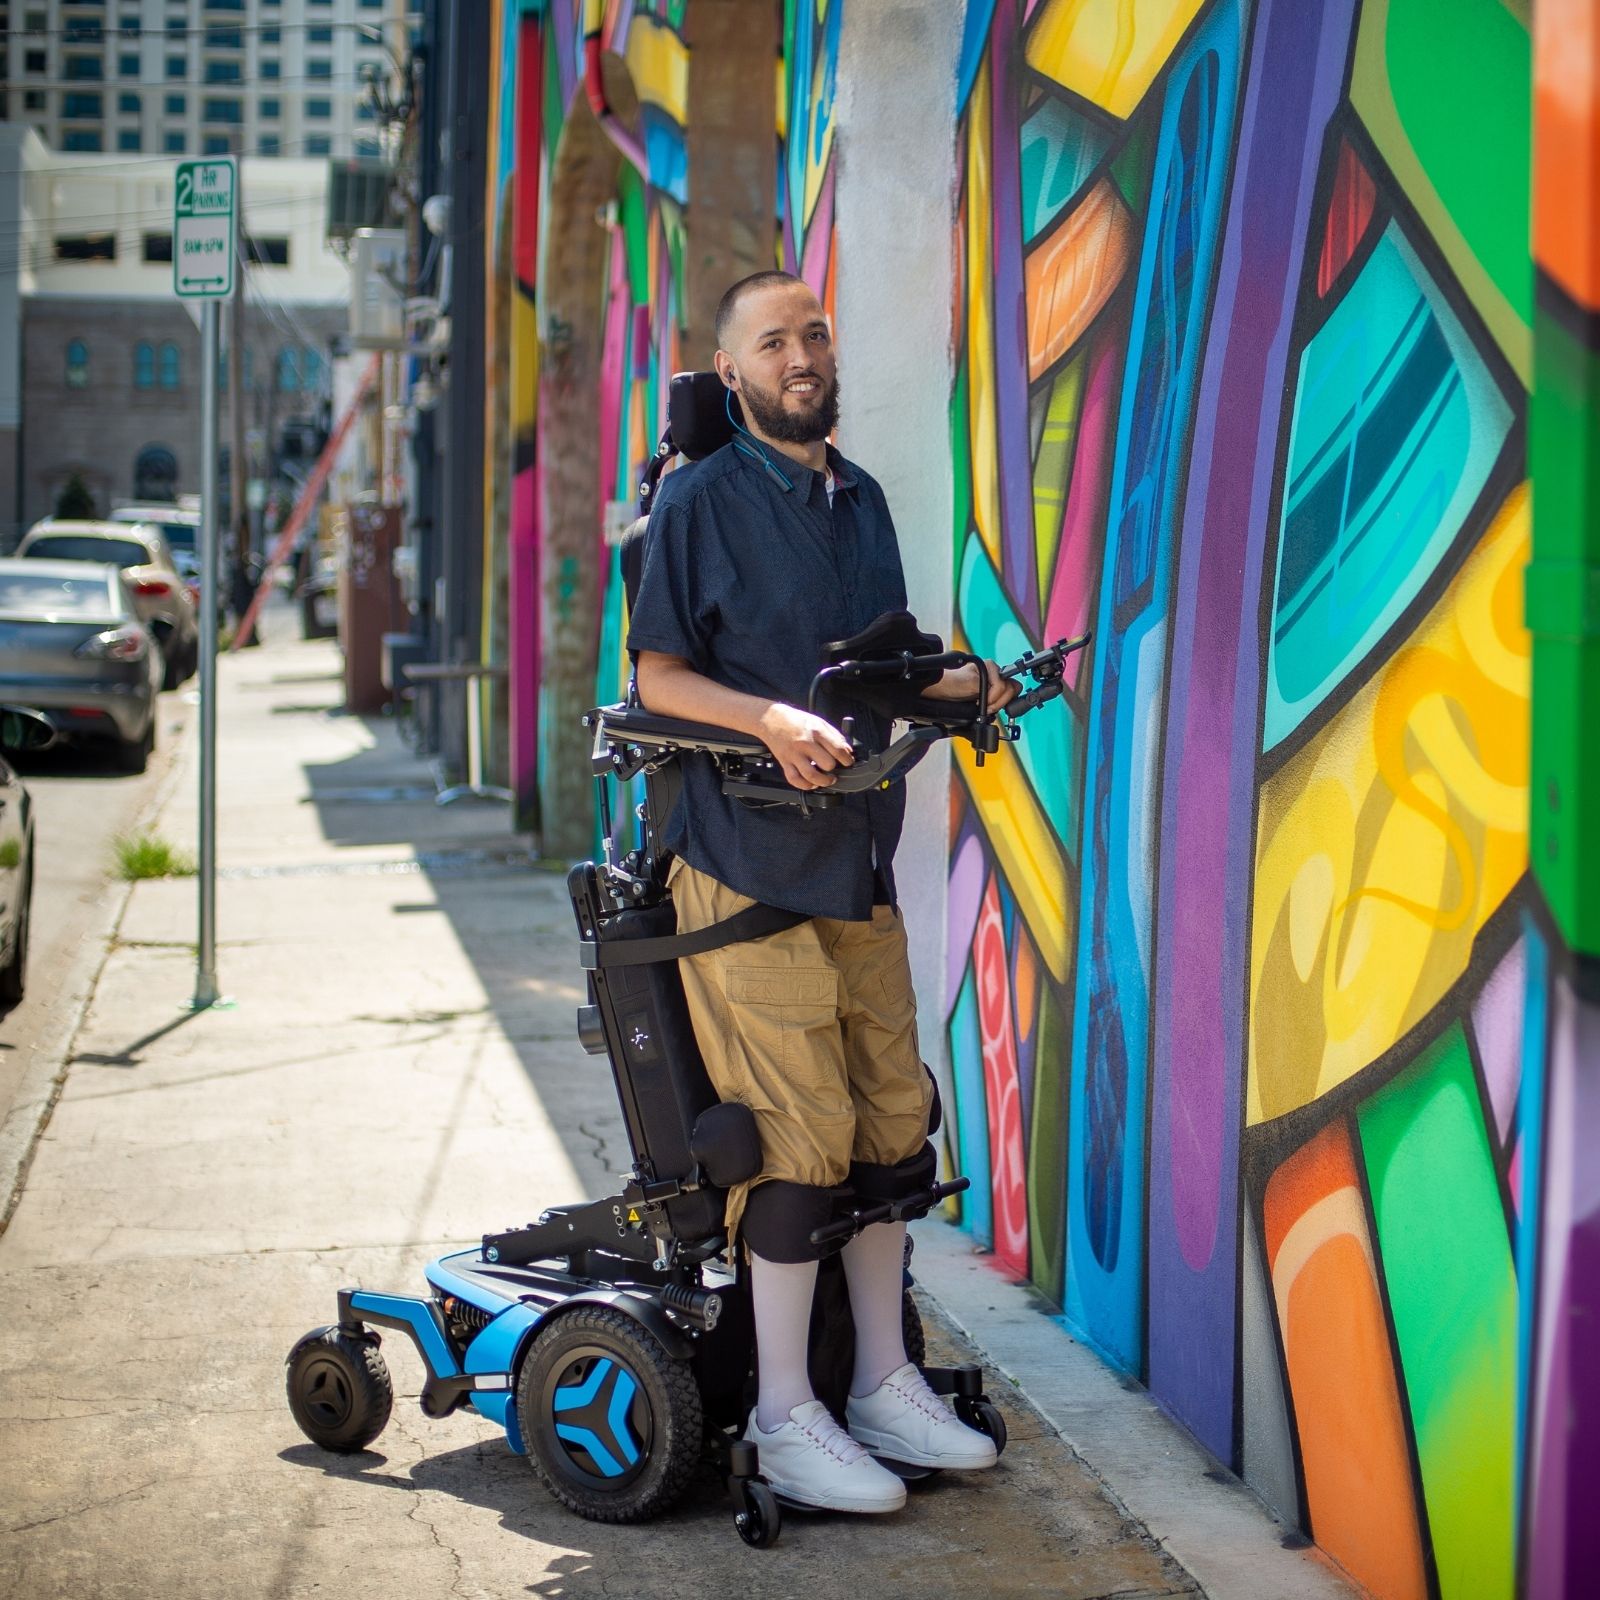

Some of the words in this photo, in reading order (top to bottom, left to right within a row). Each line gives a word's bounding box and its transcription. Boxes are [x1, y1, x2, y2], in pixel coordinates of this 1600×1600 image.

[177, 172, 192, 211] 2
[201, 170, 216, 187] HR
[193, 192, 229, 210] PARKING
